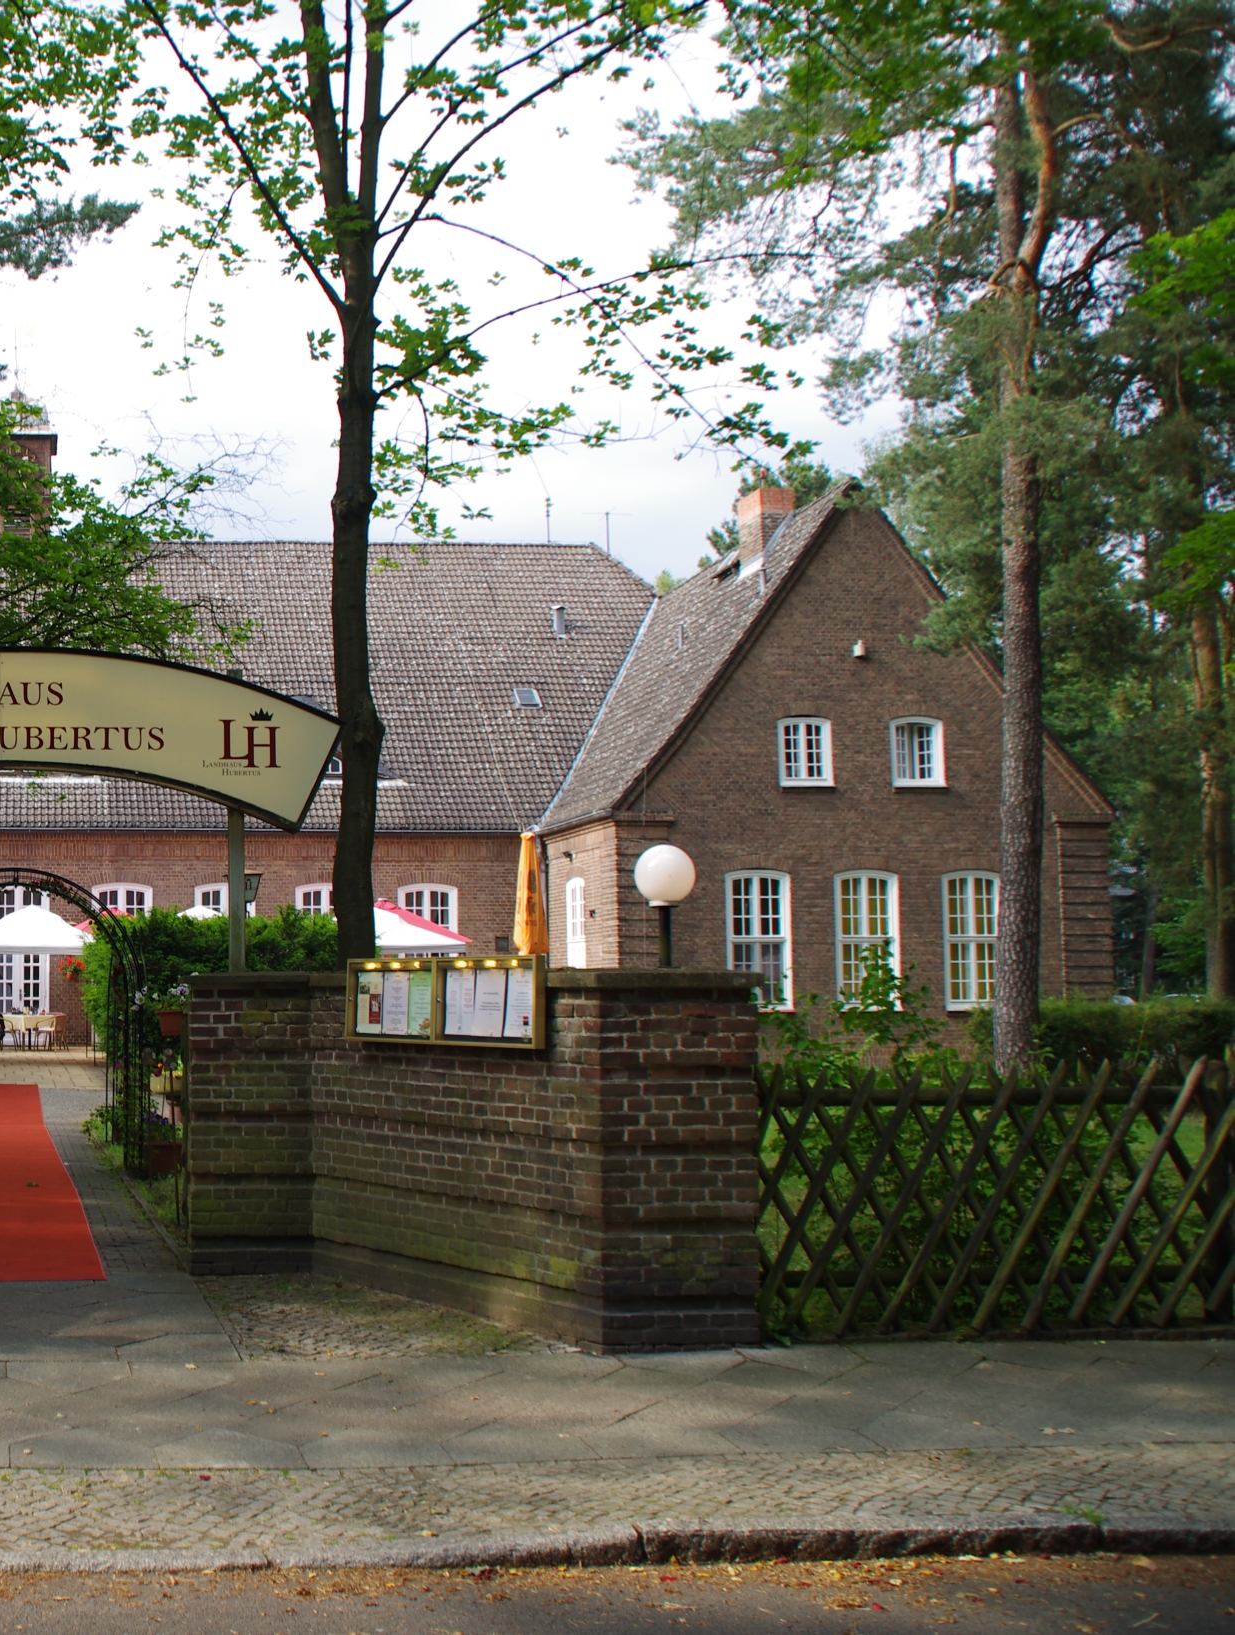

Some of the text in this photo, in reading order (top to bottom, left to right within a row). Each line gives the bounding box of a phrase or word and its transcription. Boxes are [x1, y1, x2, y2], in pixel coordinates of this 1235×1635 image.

[218, 719, 281, 768] LH
[202, 760, 243, 768] LANDHAUS
[222, 768, 261, 776] HUBERTUS
